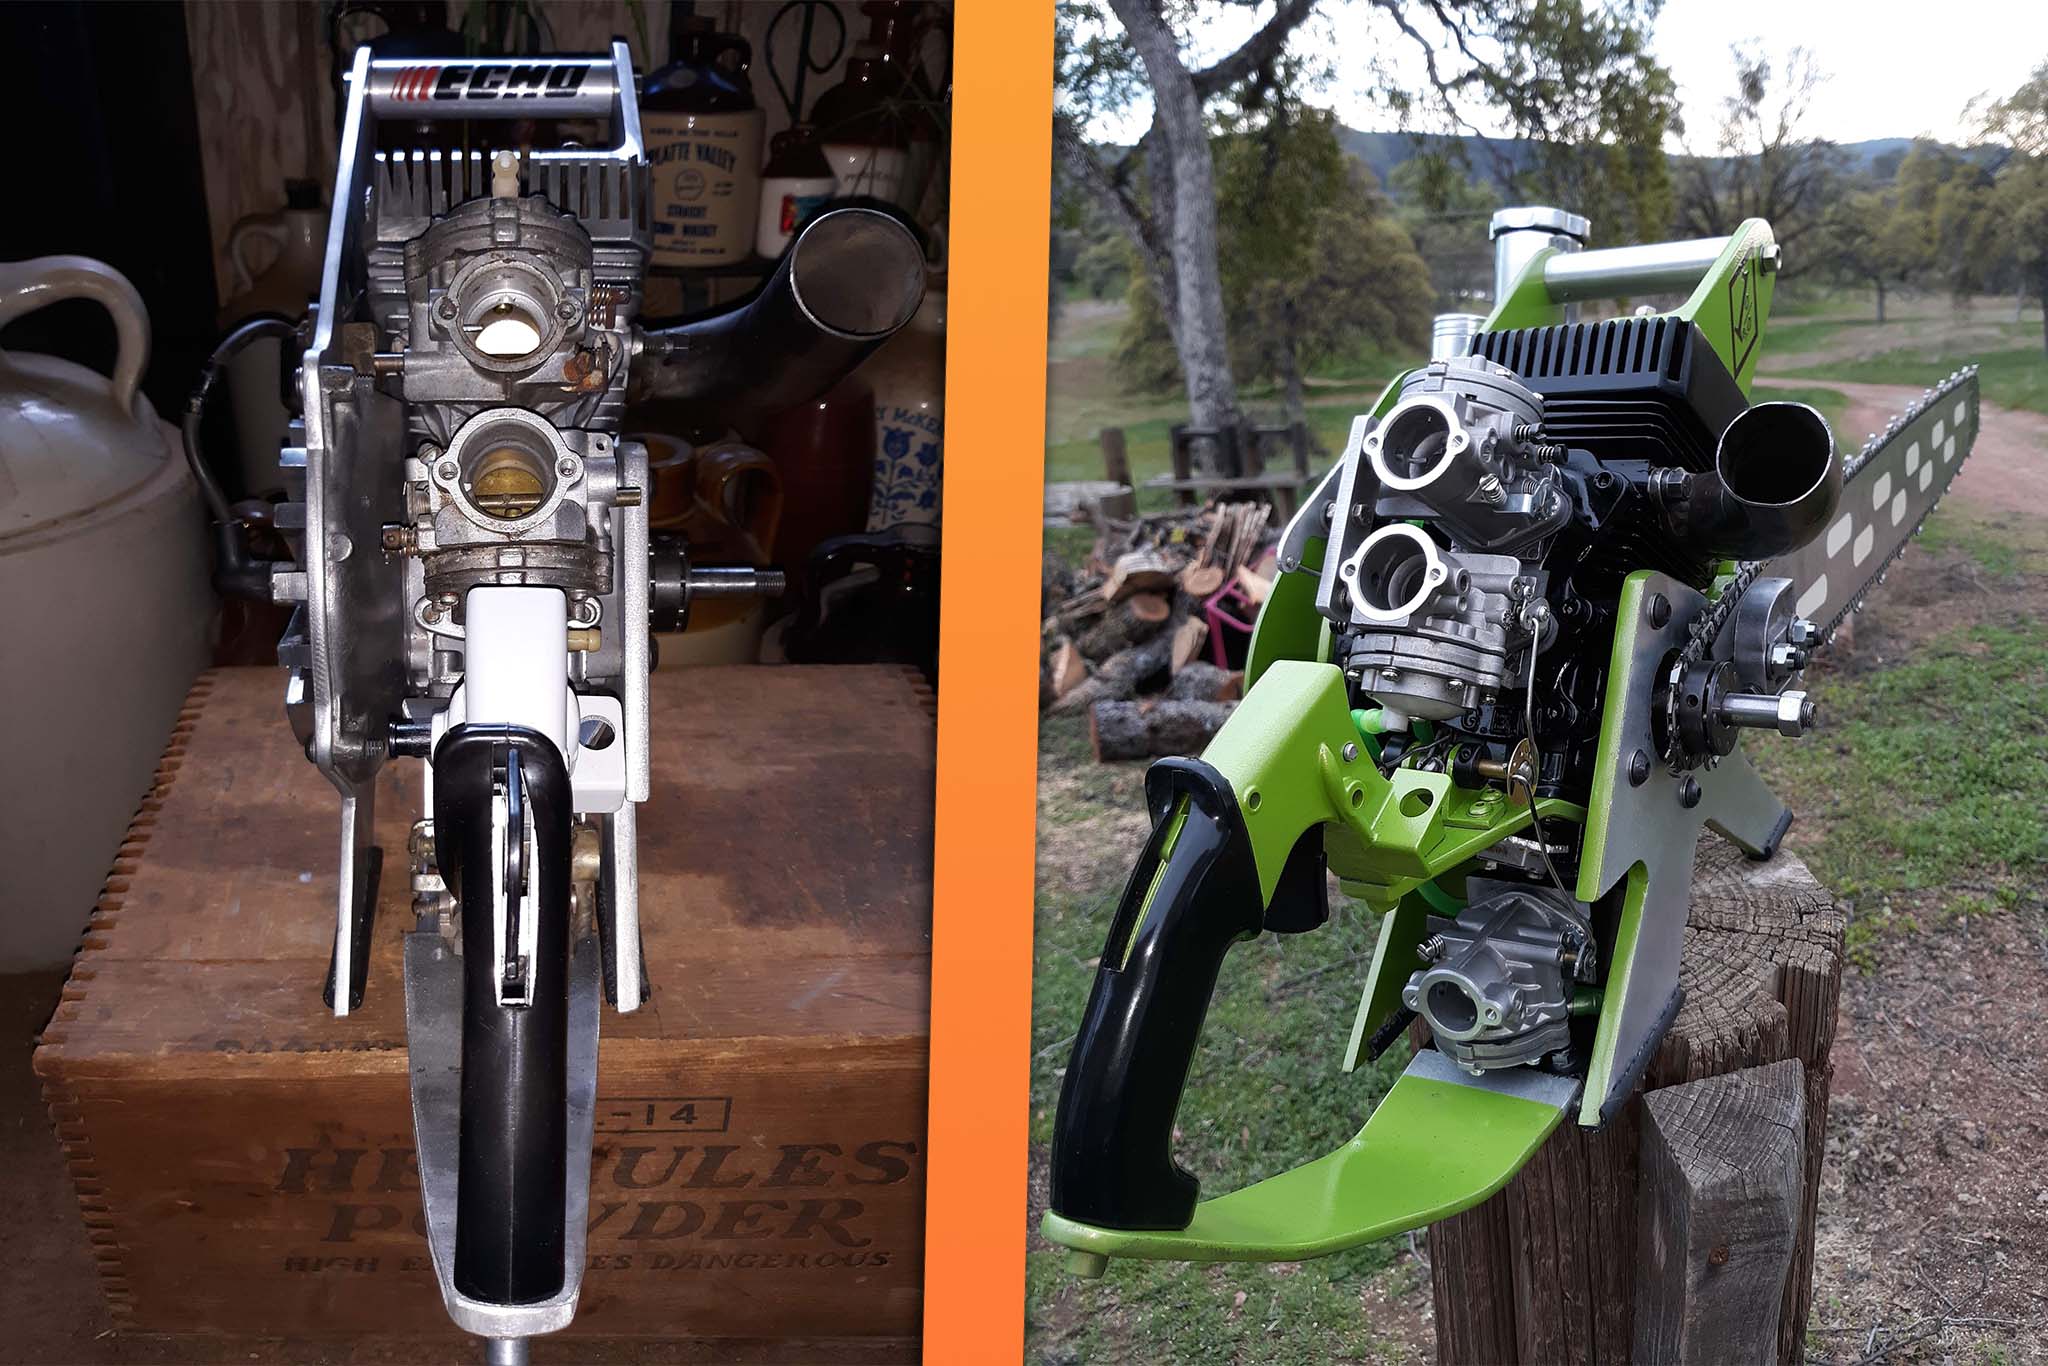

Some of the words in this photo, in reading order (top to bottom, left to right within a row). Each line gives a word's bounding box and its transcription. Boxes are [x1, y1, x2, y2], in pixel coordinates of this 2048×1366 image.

[434, 65, 591, 100] ECHO
[696, 143, 736, 173] VALLEY
[282, 1256, 380, 1273] HIGH
[650, 1251, 892, 1271] DANGEROUS
